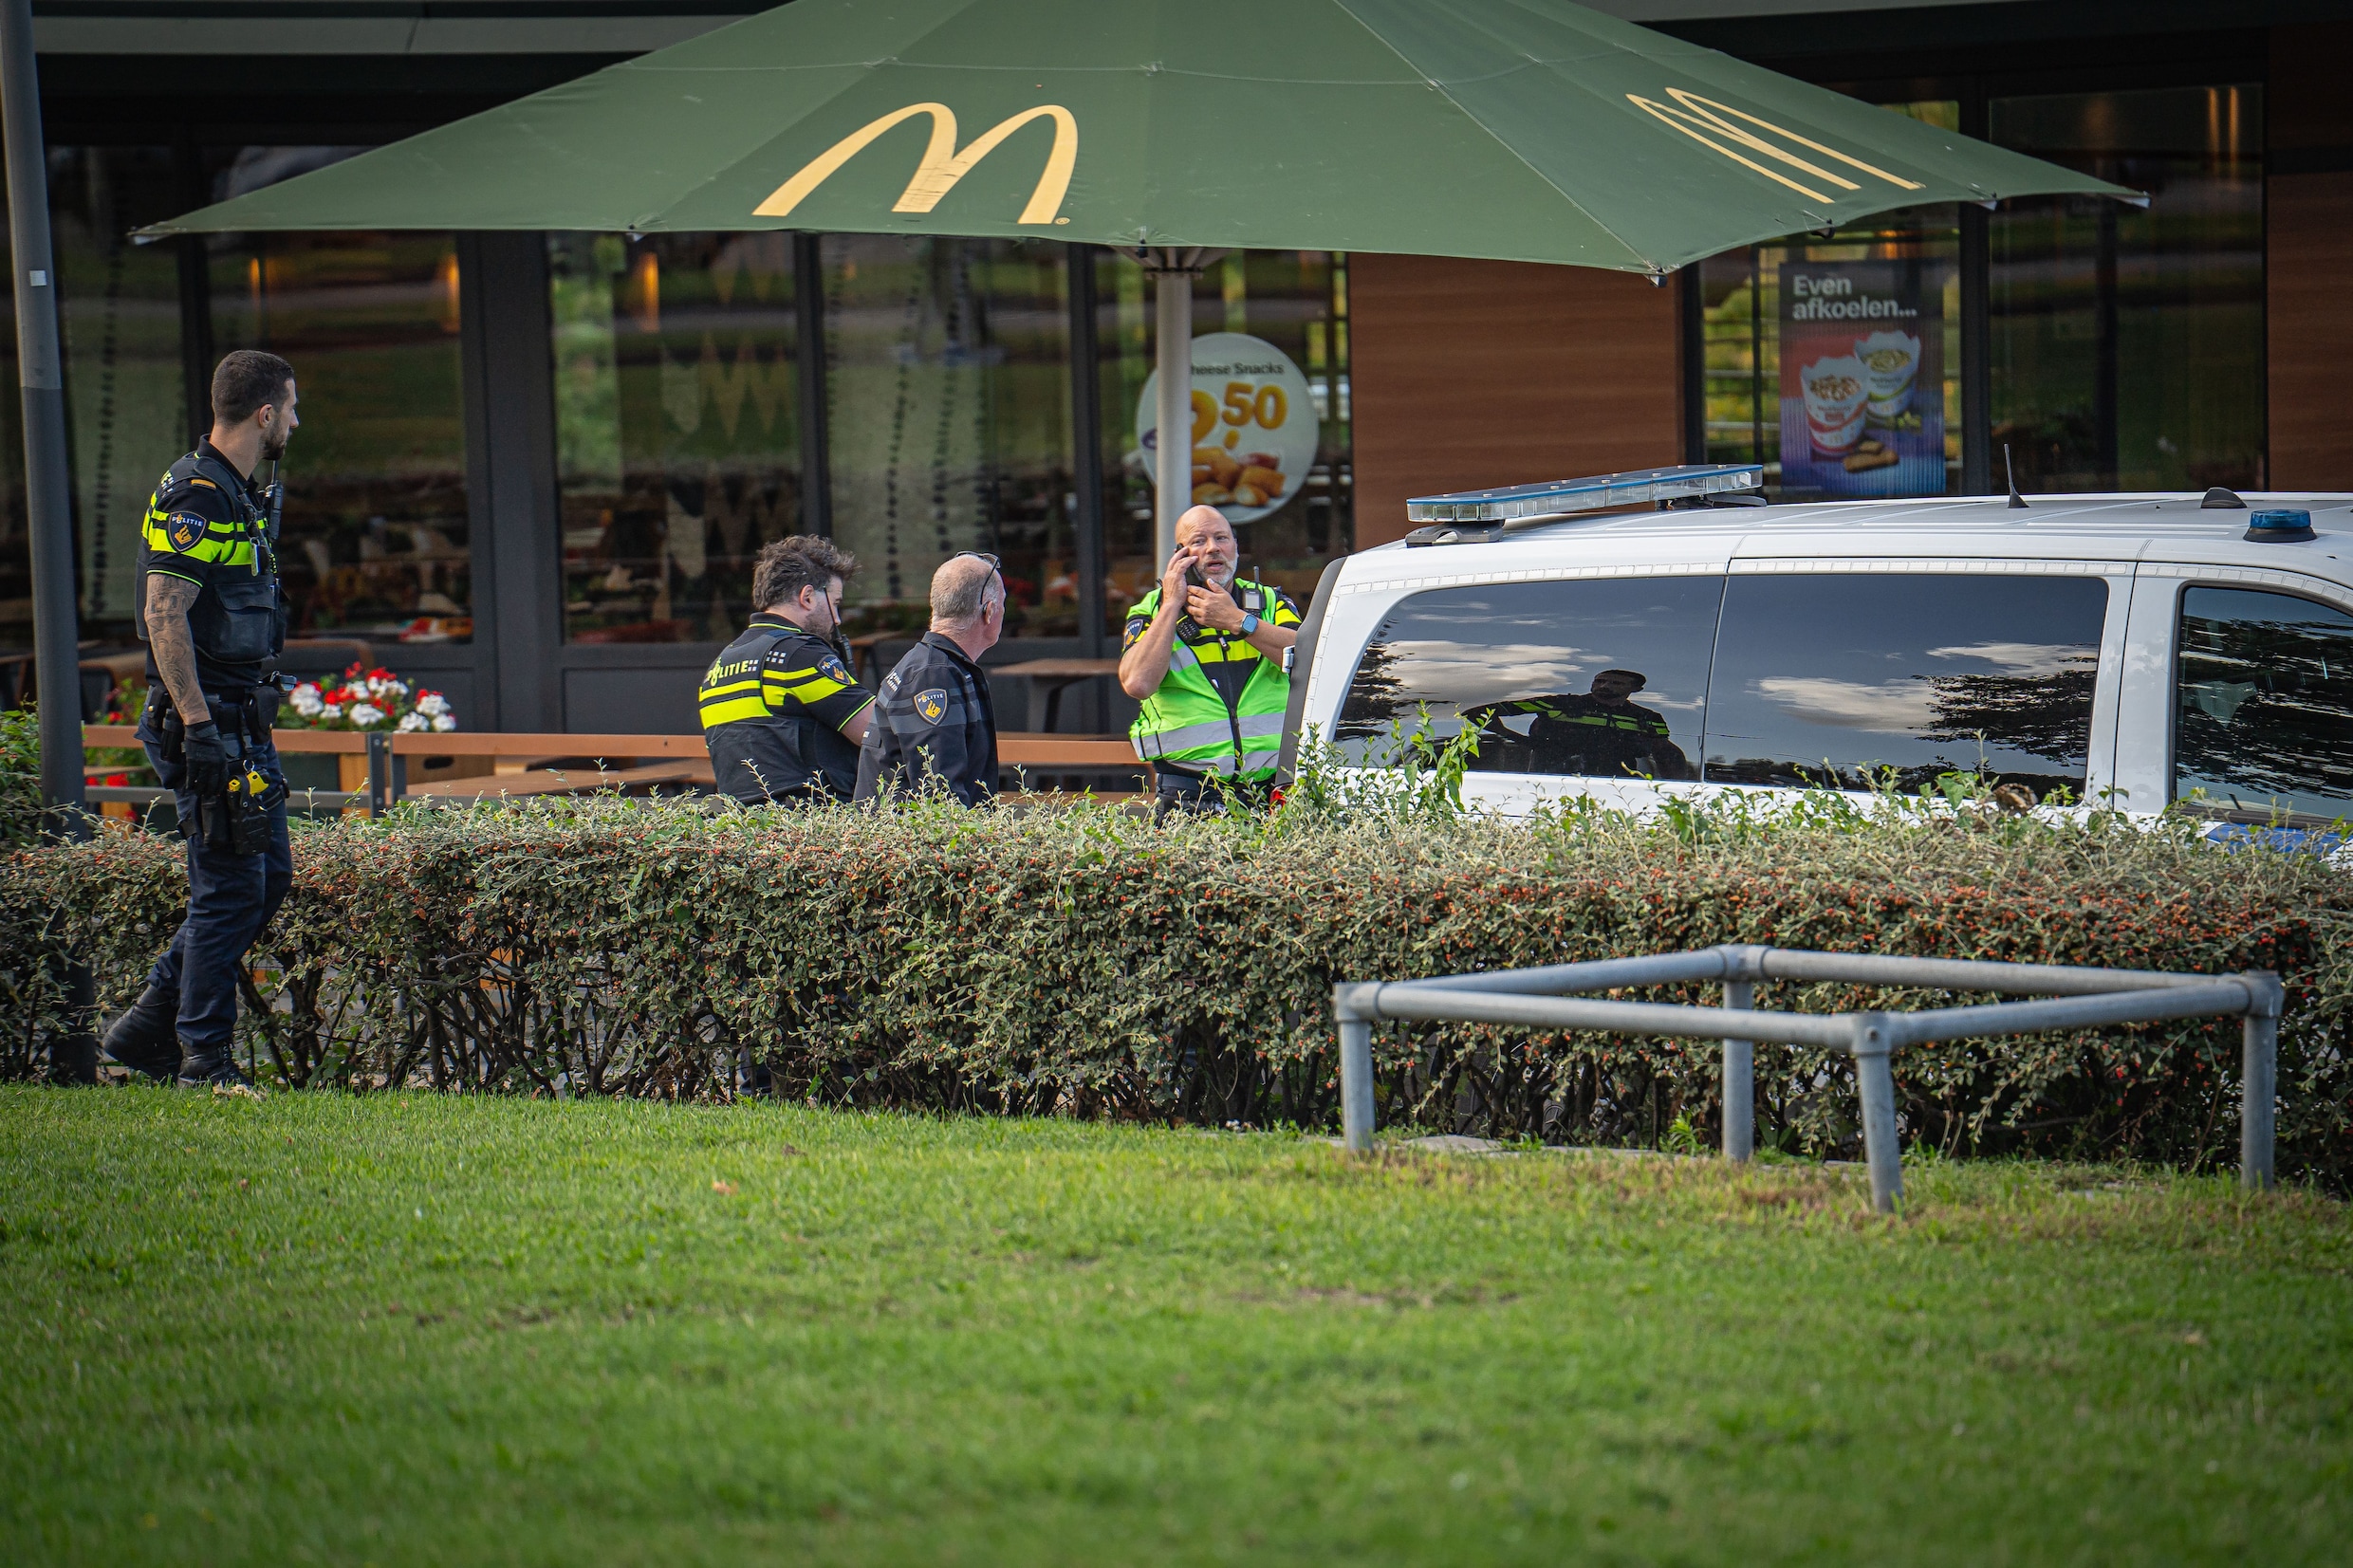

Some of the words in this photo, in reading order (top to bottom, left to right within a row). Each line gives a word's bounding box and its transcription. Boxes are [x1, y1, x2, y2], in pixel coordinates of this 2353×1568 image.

[1792, 274, 1852, 296] Even
[1792, 295, 1918, 320] afkoelen...
[1191, 362, 1232, 375] heese
[1234, 361, 1285, 375] Snacks
[172, 513, 204, 527] POLITIE
[705, 656, 750, 687] POLITIE
[917, 693, 944, 703] POLITIE
